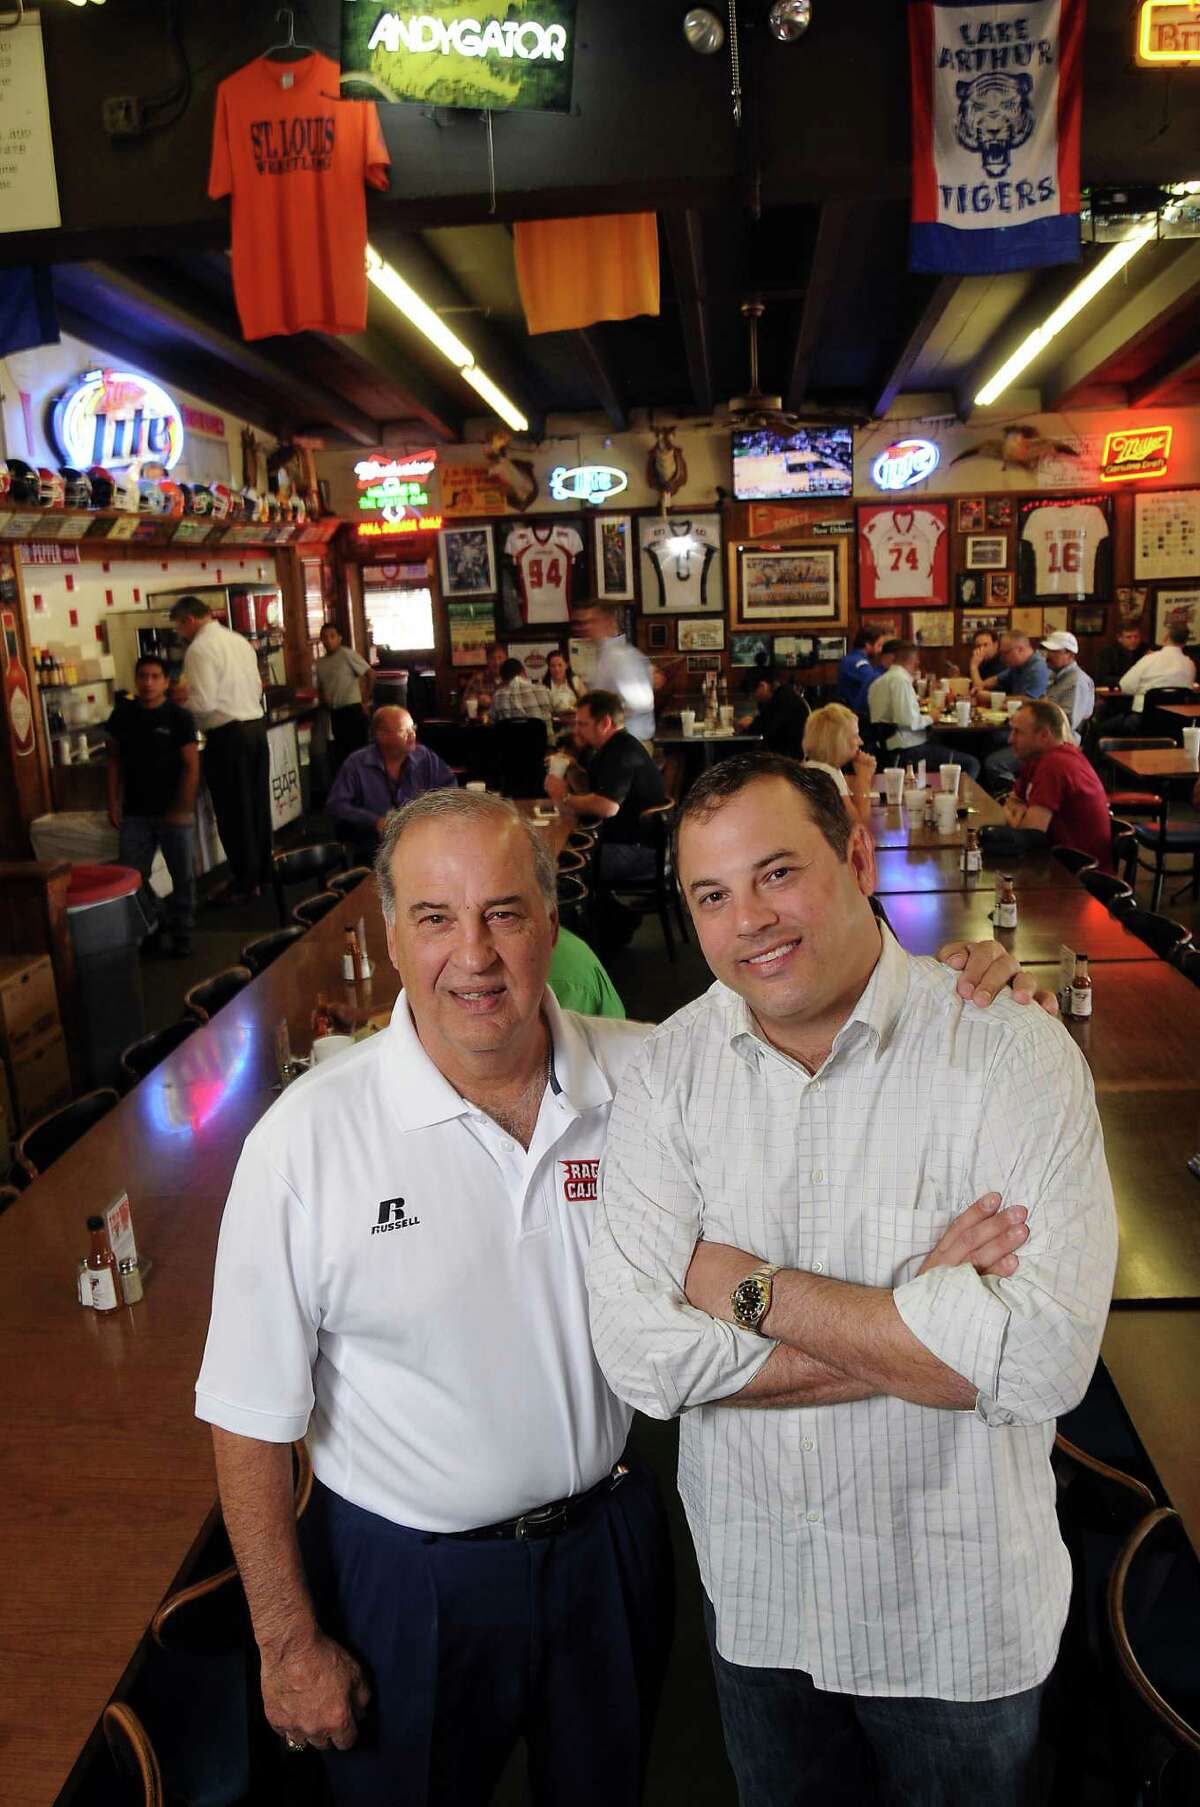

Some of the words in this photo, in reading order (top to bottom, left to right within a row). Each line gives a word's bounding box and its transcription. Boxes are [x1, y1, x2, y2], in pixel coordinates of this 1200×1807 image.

[368, 12, 567, 62] ANDYGATOR
[959, 19, 1029, 46] LAKE
[938, 39, 1053, 72] ARTHUR
[279, 116, 336, 158] LOUIS
[940, 176, 1055, 213] TIGERS
[888, 547, 919, 571] 74
[1048, 542, 1081, 573] 16
[528, 558, 562, 589] 94
[371, 1216, 421, 1235] RUSSELL
